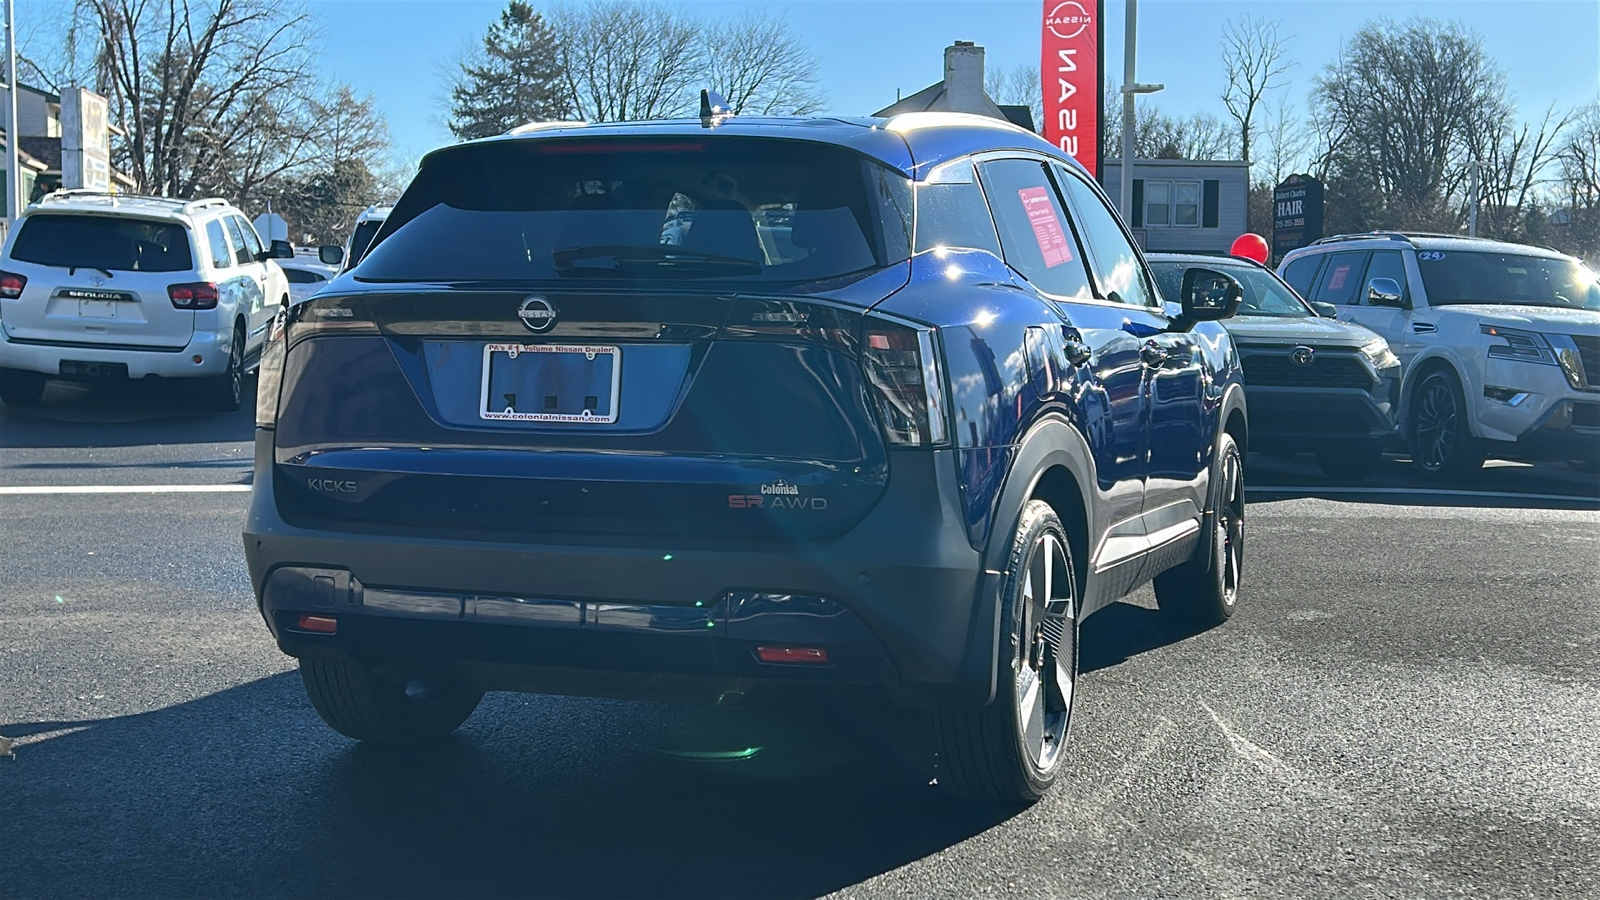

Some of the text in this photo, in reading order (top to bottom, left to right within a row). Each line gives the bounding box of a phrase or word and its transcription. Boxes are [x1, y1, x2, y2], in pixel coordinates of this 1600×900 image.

[1275, 188, 1306, 200] Robert Charles
[1277, 200, 1303, 216] HAIR
[1423, 252, 1441, 260] 24
[69, 290, 121, 300] SEQUOIA
[518, 310, 556, 318] NISSAN
[507, 345, 519, 354] #1
[585, 346, 615, 354] Dealer!
[484, 412, 610, 422] www.colonialnissan.com
[308, 478, 358, 493] KICKS
[761, 484, 799, 495] Colonial
[728, 494, 828, 510] SR AWD
